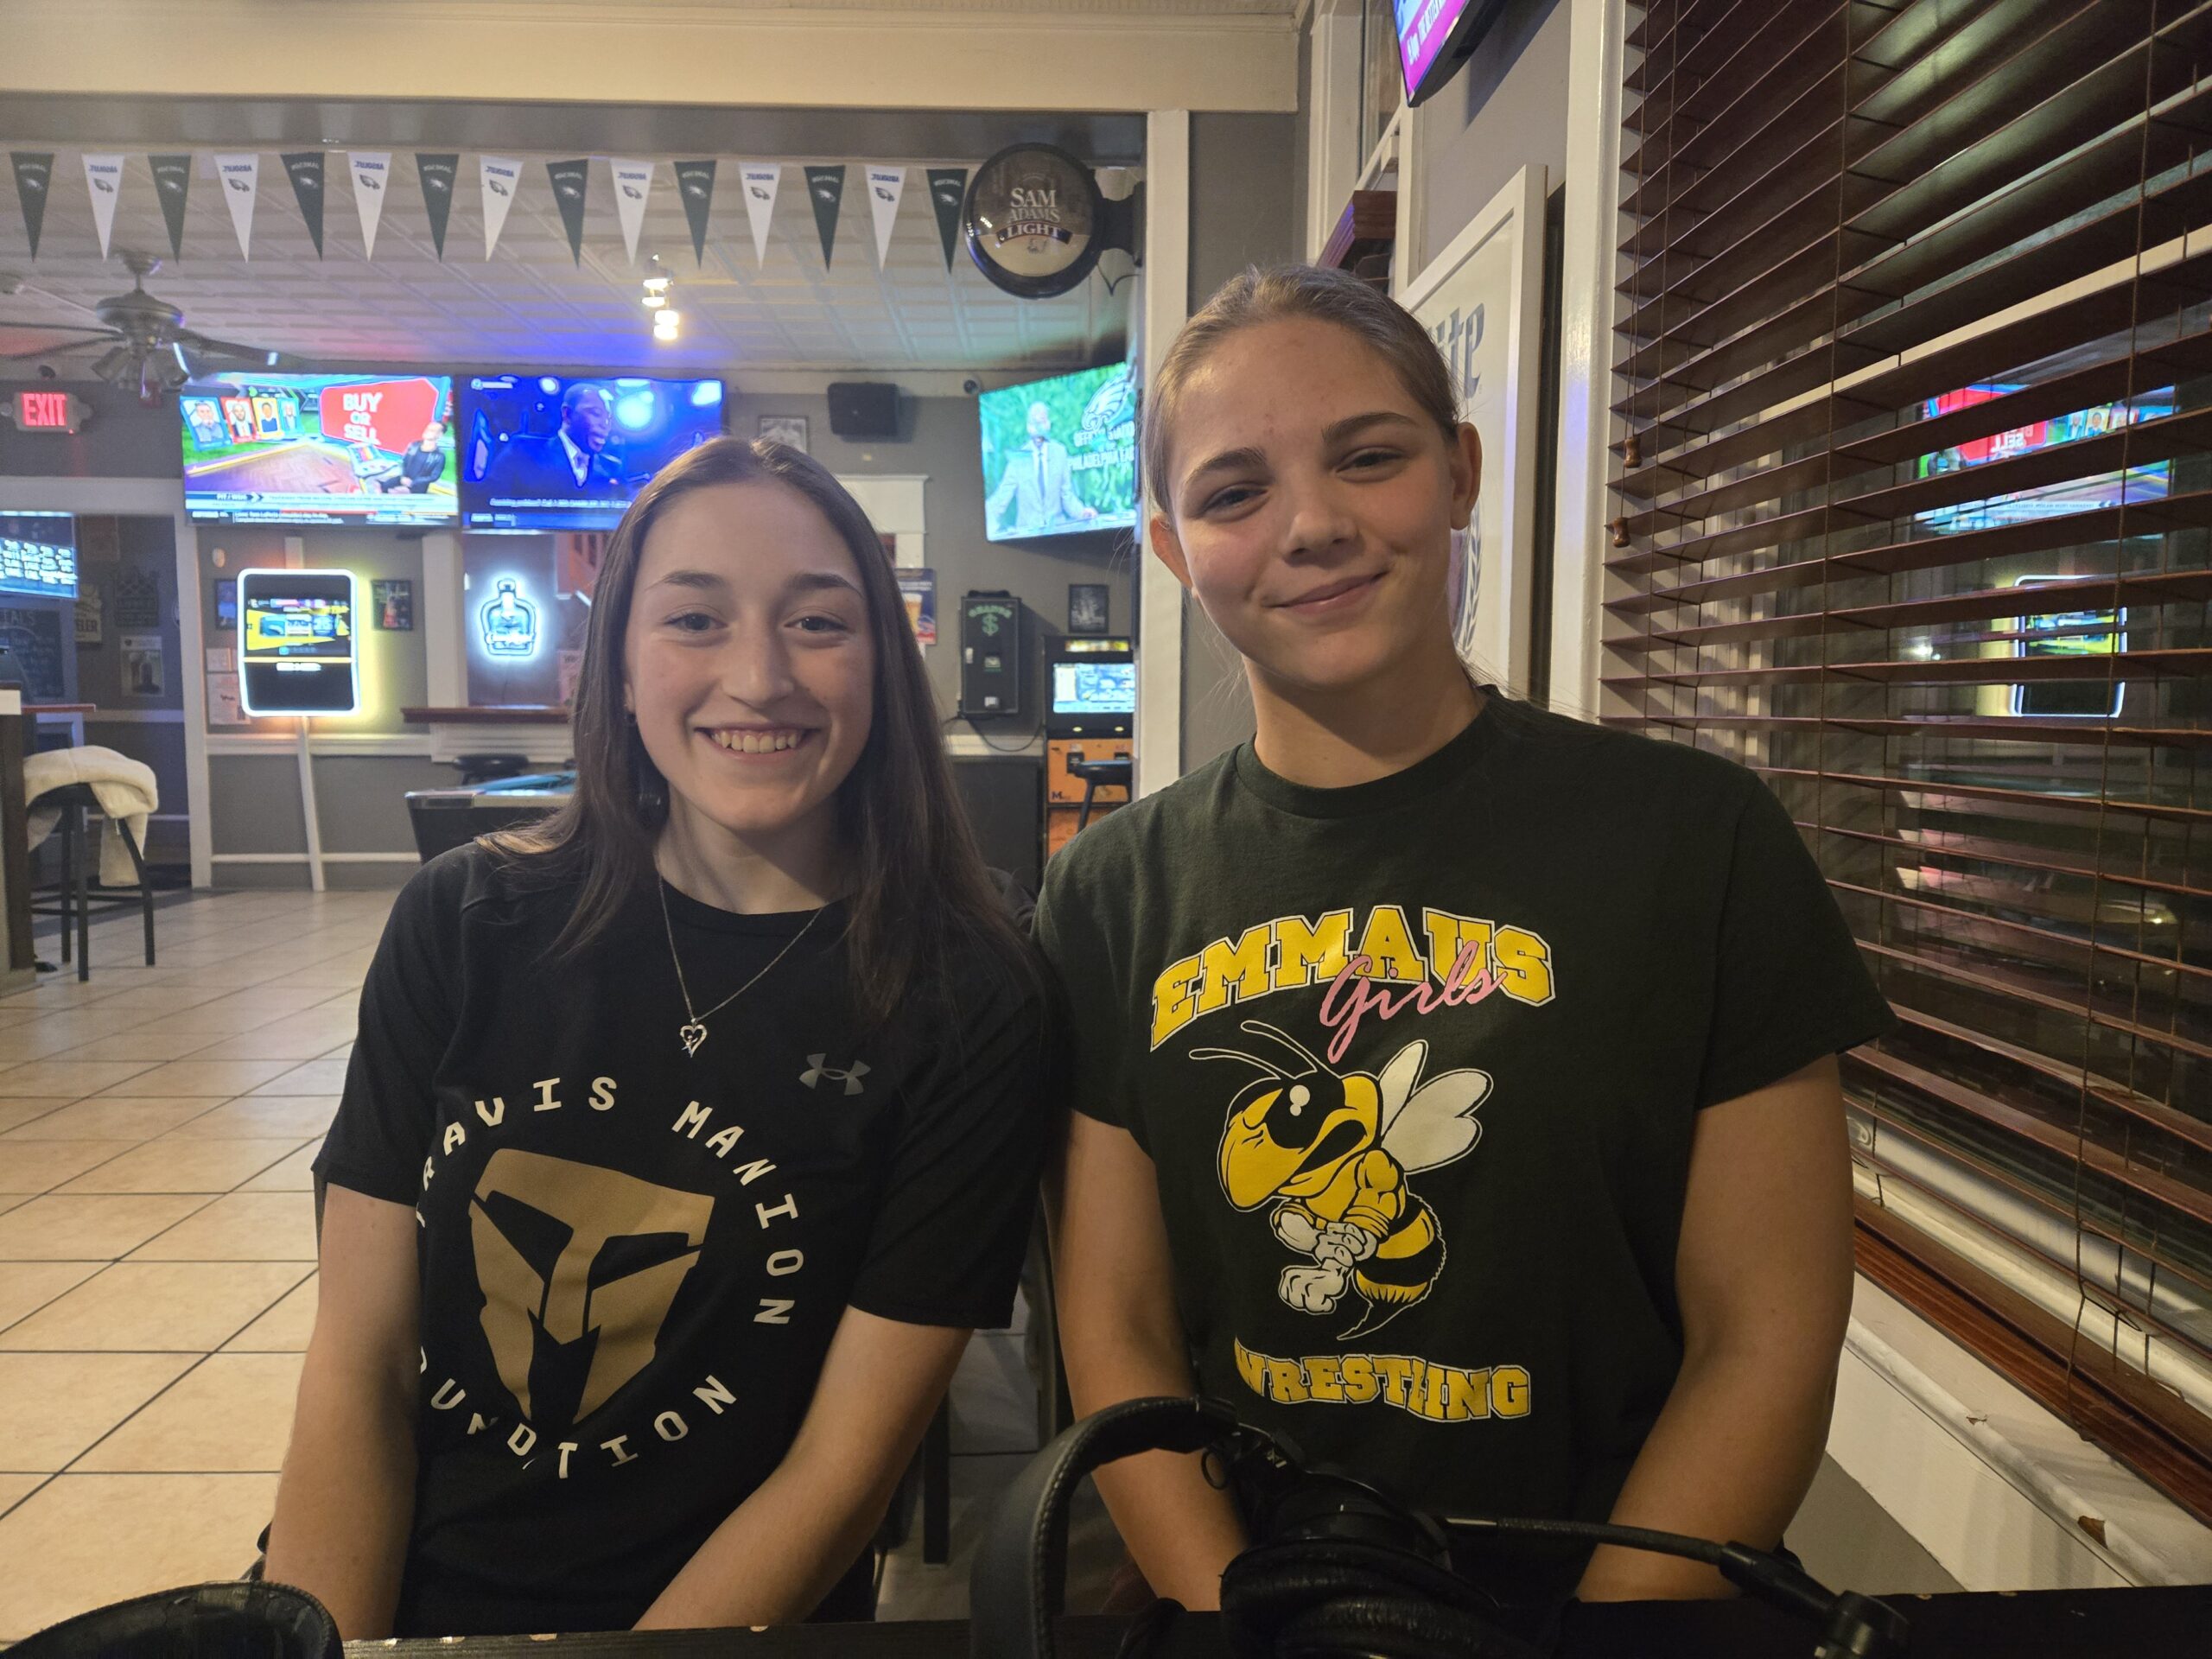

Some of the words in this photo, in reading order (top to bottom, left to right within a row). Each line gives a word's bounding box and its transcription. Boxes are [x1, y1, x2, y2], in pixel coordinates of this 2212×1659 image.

[1010, 188, 1057, 207] SAM
[1007, 208, 1060, 224] ADAMS
[1007, 223, 1060, 238] LIGHT
[22, 393, 67, 426] EXIT
[343, 392, 383, 412] BUY
[350, 410, 372, 426] OR
[344, 423, 382, 445] SELL
[1150, 905, 1556, 1052] EMMAUS
[1319, 939, 1509, 1065] Girls
[416, 1077, 617, 1228] RAVIS
[671, 1100, 804, 1325] MANION
[1233, 1336, 1531, 1423] WRESTLING
